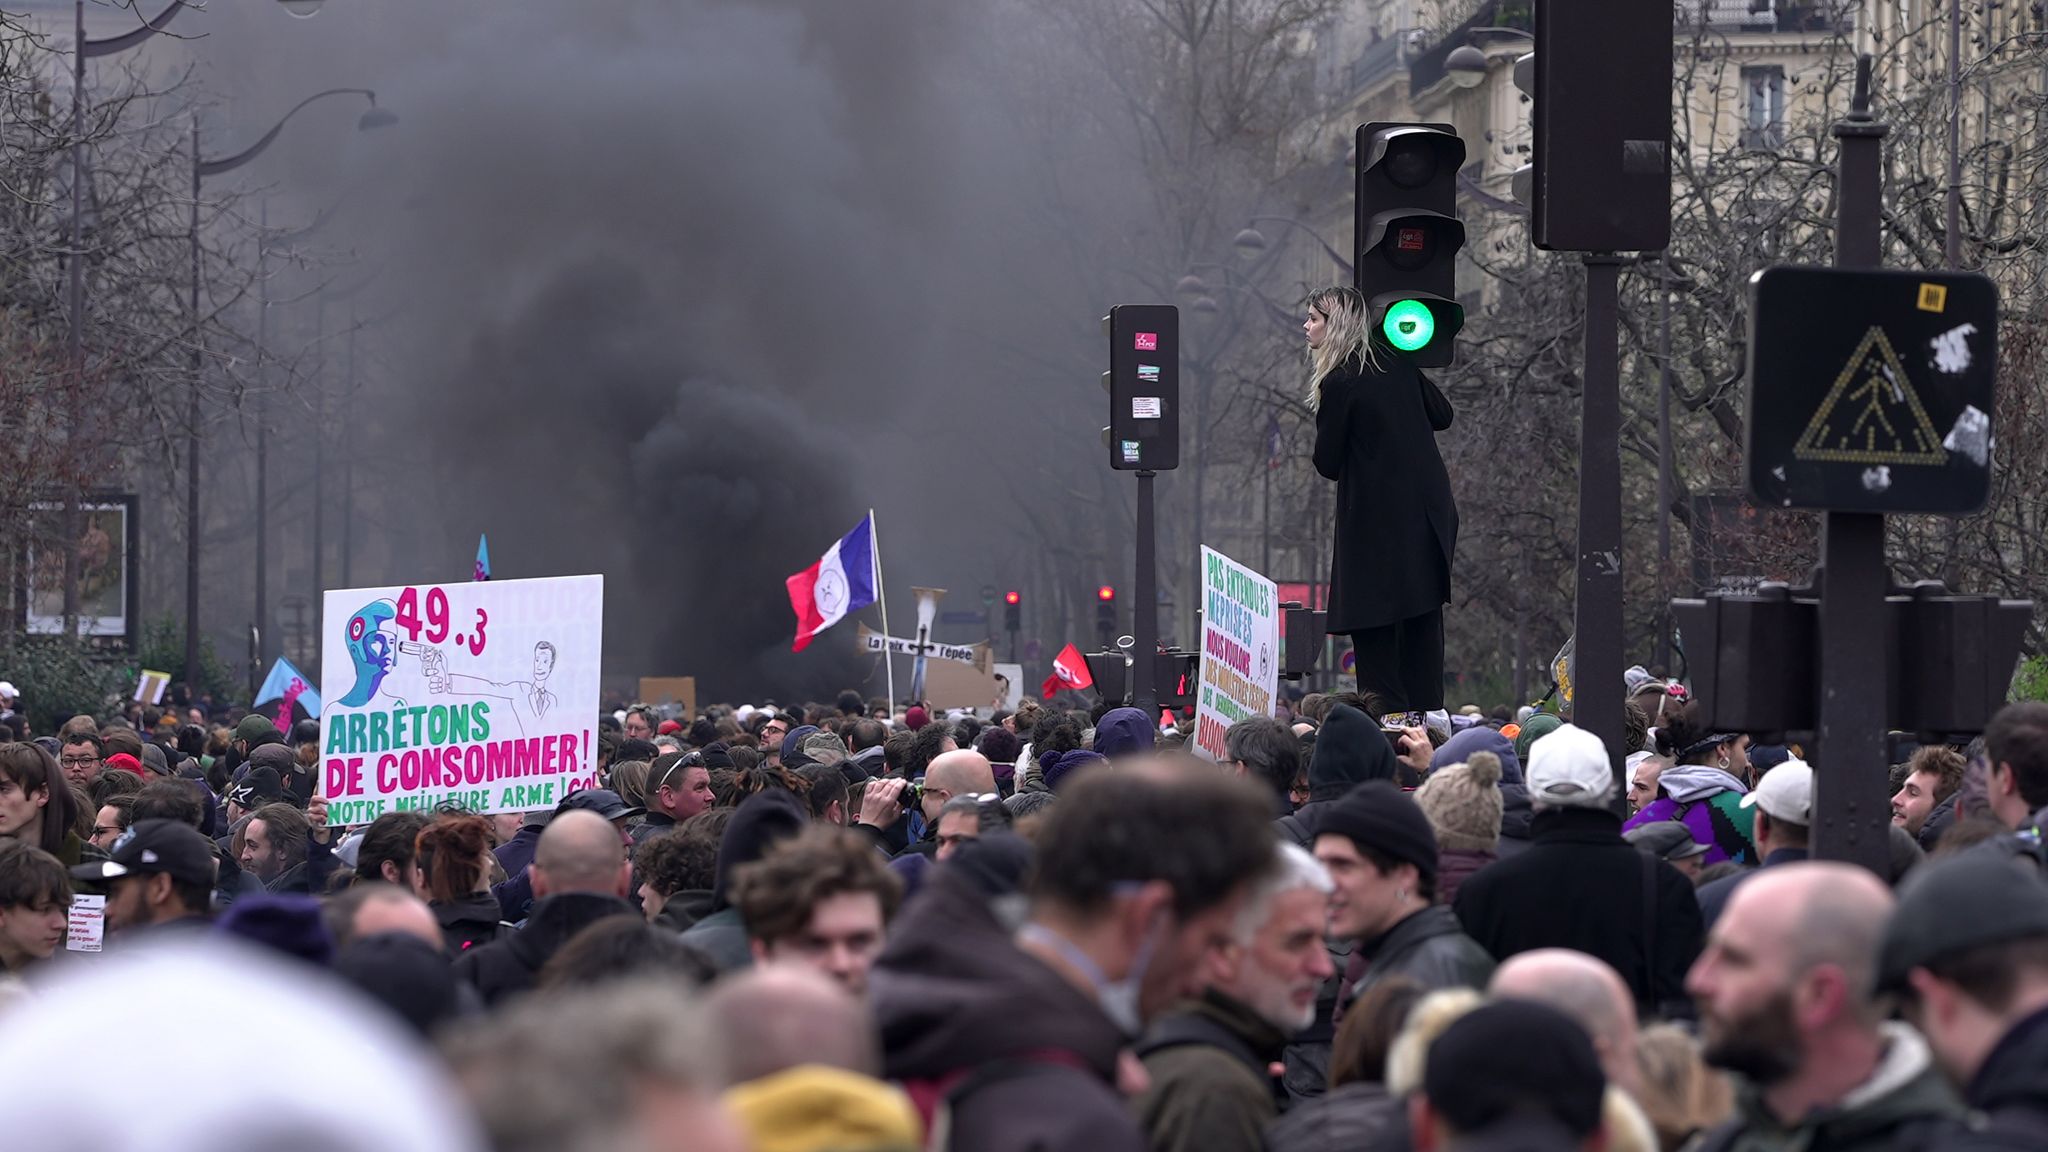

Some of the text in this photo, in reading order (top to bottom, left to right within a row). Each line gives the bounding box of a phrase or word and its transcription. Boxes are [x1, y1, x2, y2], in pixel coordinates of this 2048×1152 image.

[1207, 552, 1224, 592] PAS
[1206, 627, 1250, 679] NOUS VOULONS
[325, 699, 491, 755] ARRÊTONS
[326, 757, 364, 799] DE
[326, 799, 386, 826] NOTRE
